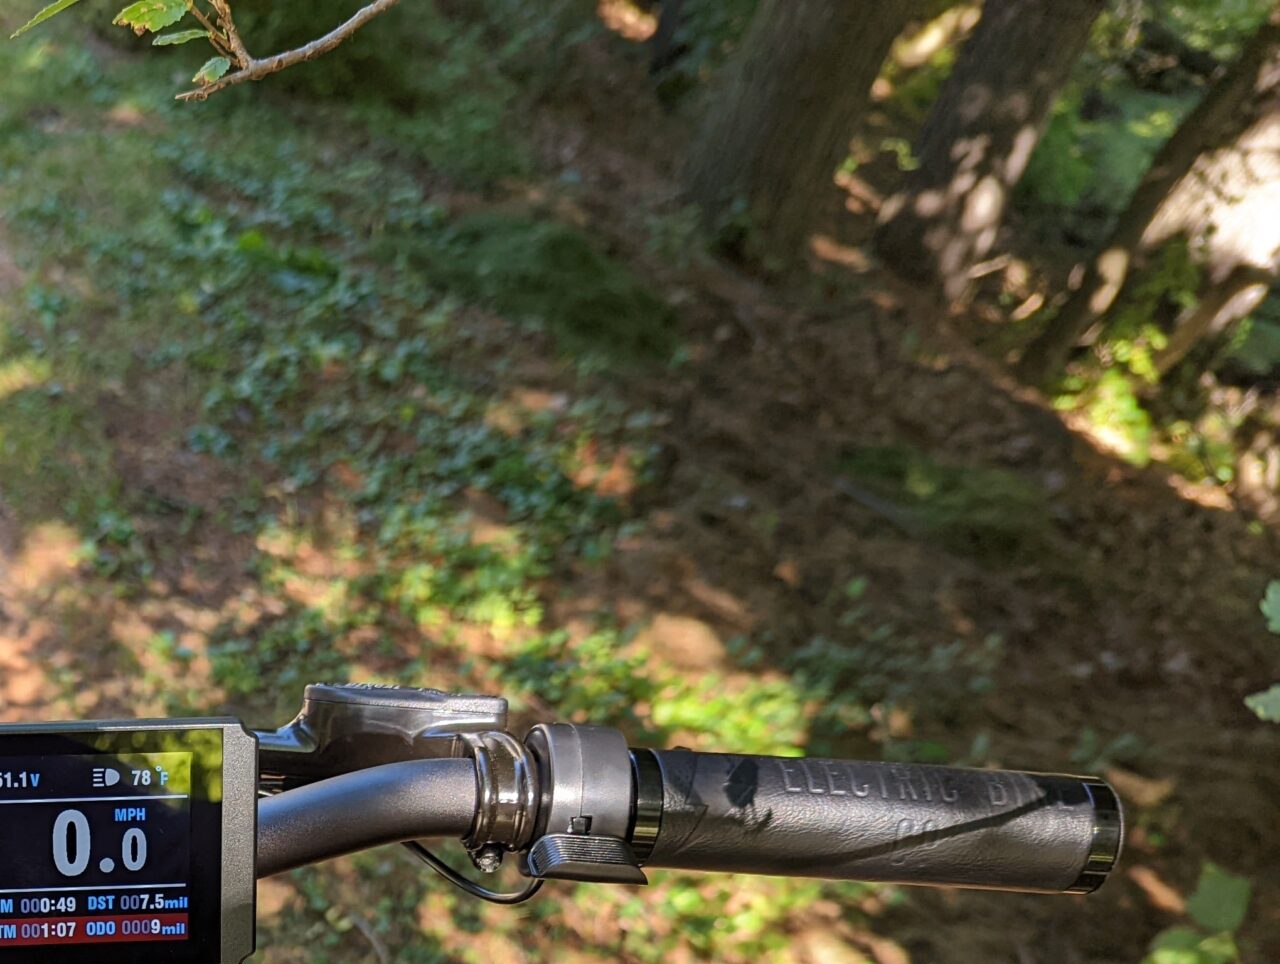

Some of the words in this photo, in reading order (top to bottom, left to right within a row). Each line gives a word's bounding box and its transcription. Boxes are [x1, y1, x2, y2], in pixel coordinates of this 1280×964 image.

[131, 769, 152, 786] 78
[778, 759, 959, 803] ELECTRIC
[114, 807, 146, 822] MPH
[52, 808, 147, 877] 0.0
[20, 896, 77, 914] 000:49
[87, 895, 115, 910] DST
[21, 921, 77, 938] 001:07
[86, 920, 116, 936] ODO
